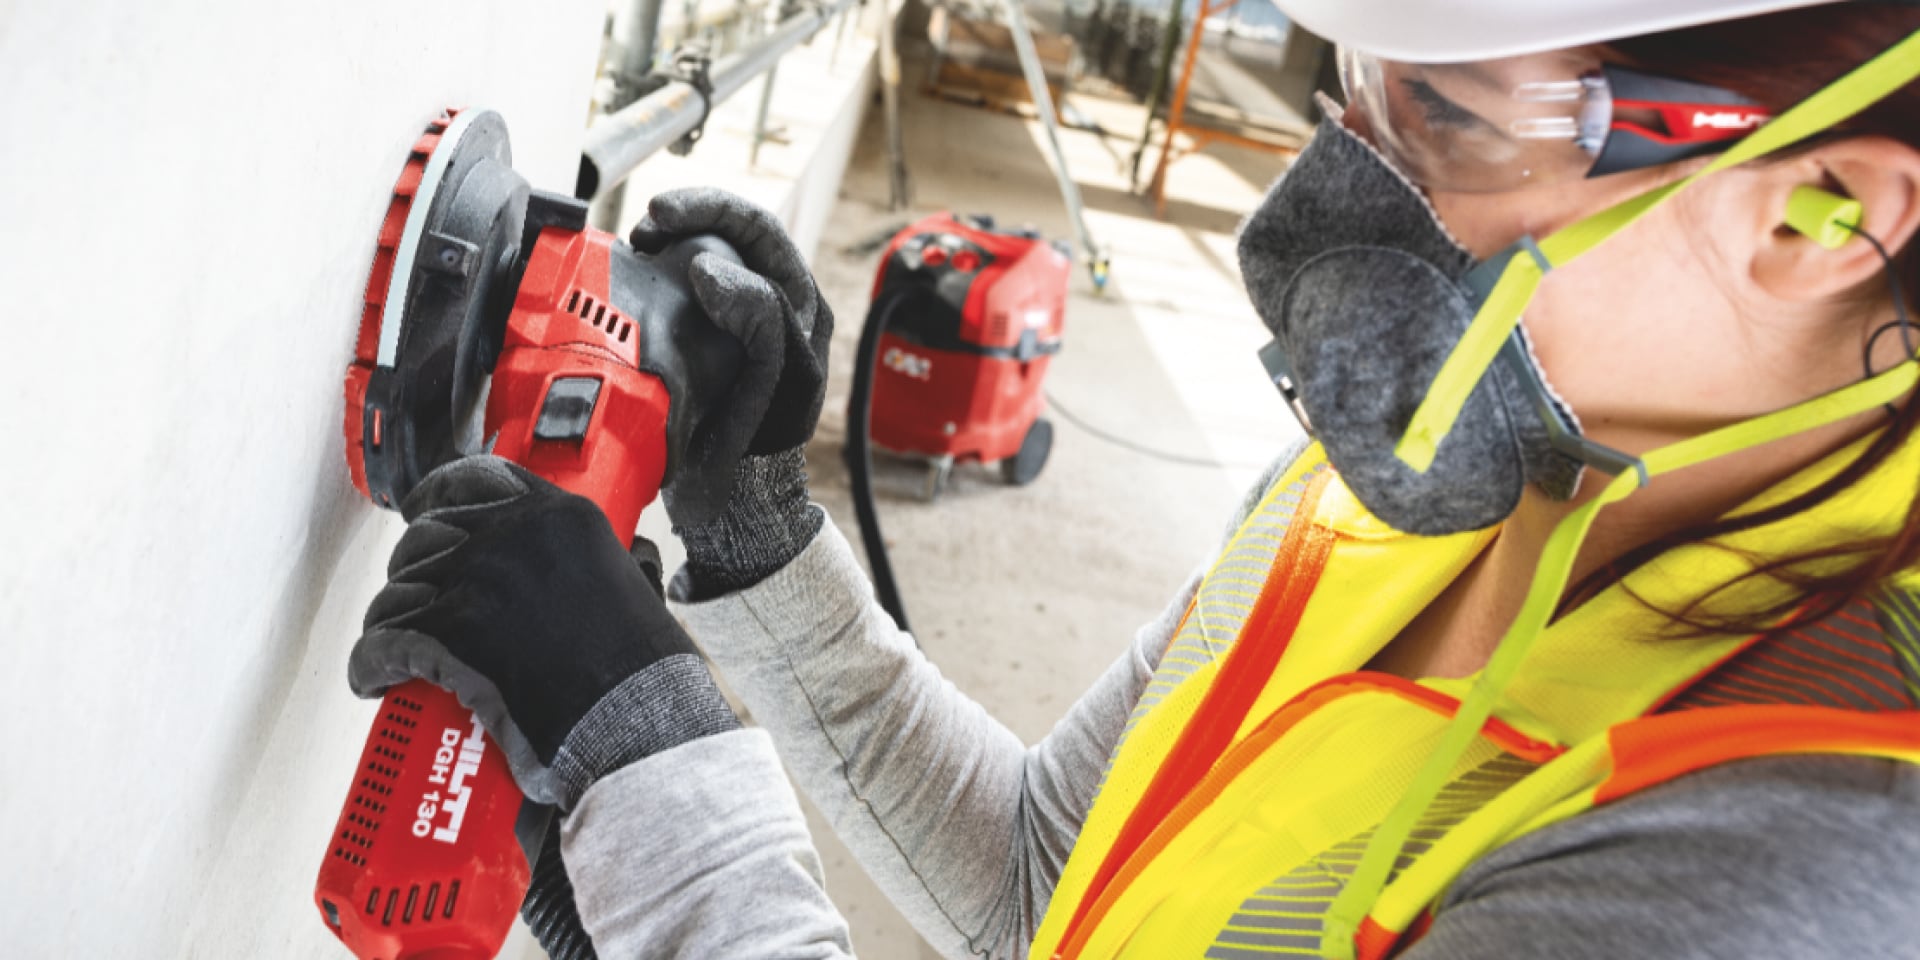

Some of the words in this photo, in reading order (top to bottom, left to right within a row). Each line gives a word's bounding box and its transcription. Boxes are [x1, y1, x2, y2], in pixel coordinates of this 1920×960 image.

[1693, 111, 1769, 129] HILT
[428, 728, 461, 784] DGH
[432, 713, 486, 844] HILTI
[412, 791, 440, 837] 130
